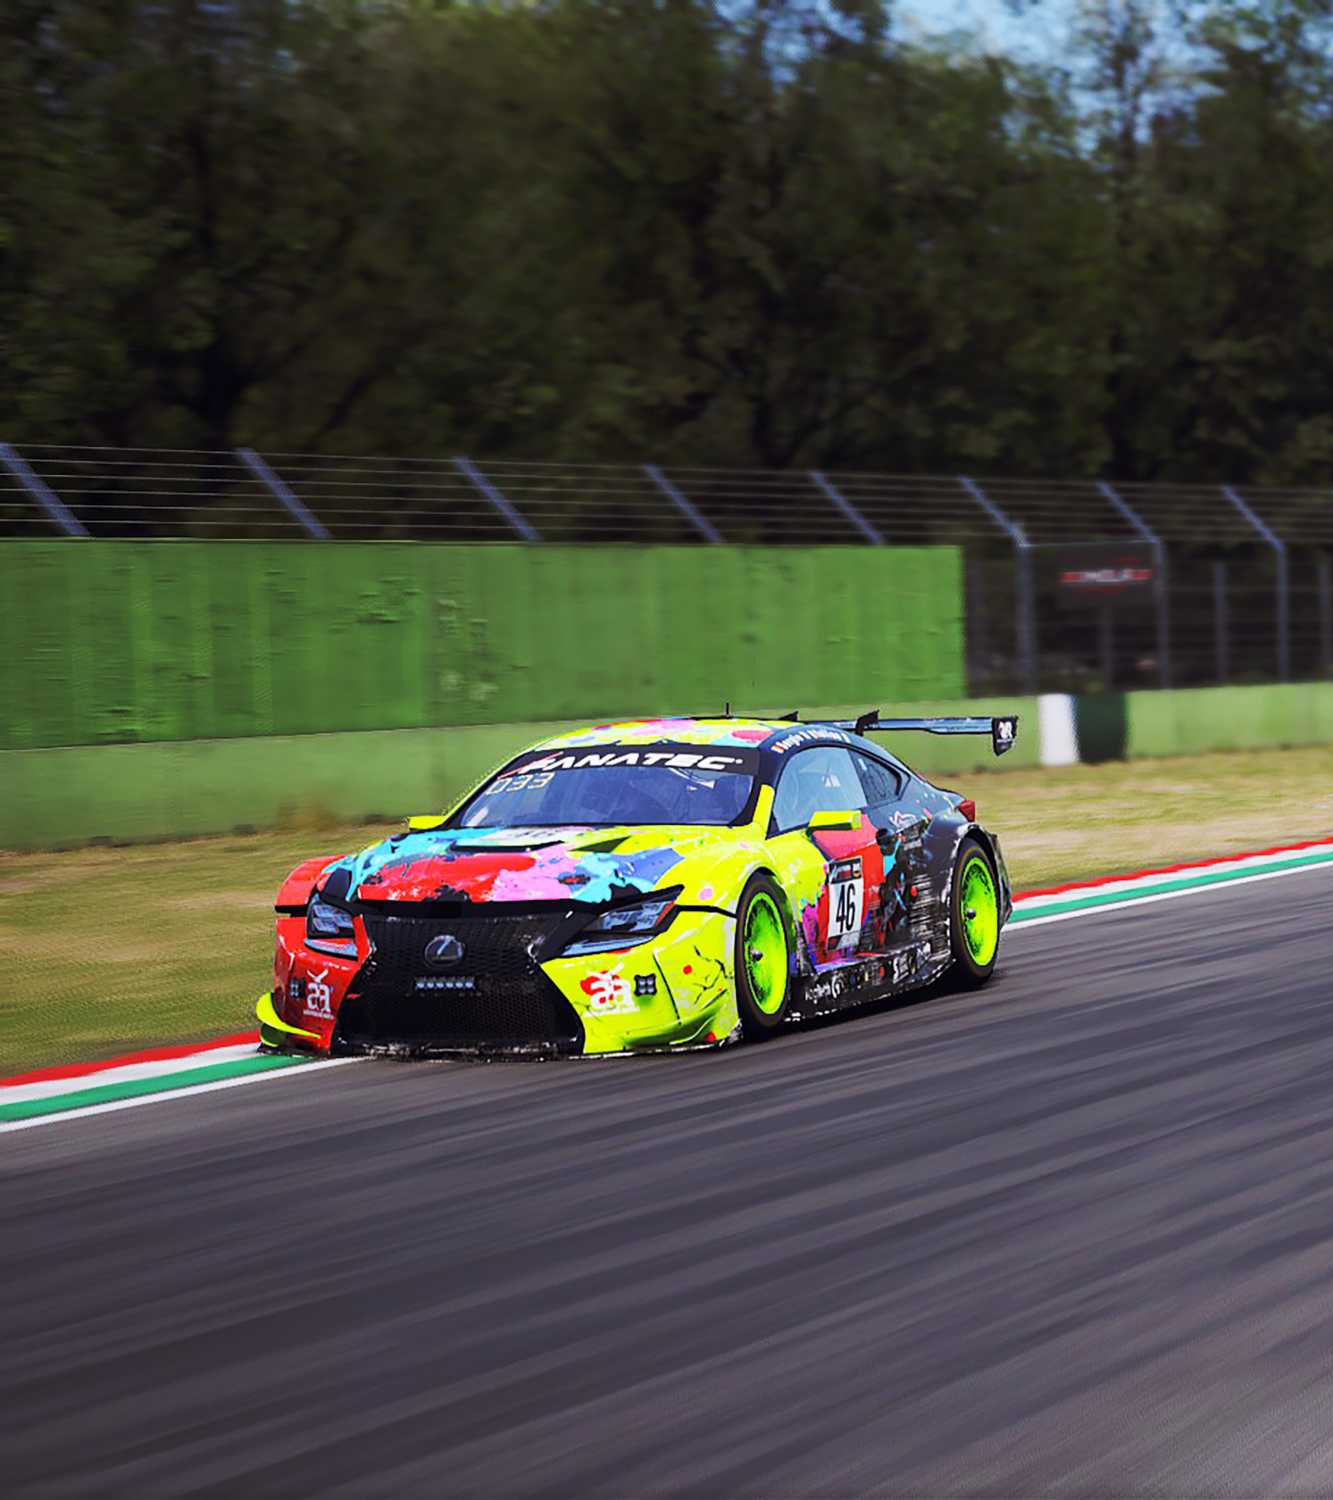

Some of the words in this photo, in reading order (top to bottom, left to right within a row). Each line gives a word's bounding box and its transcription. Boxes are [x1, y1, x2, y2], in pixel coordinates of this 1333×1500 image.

[517, 752, 736, 775] FANATEC
[484, 772, 555, 796] 033
[836, 883, 856, 933] 46
